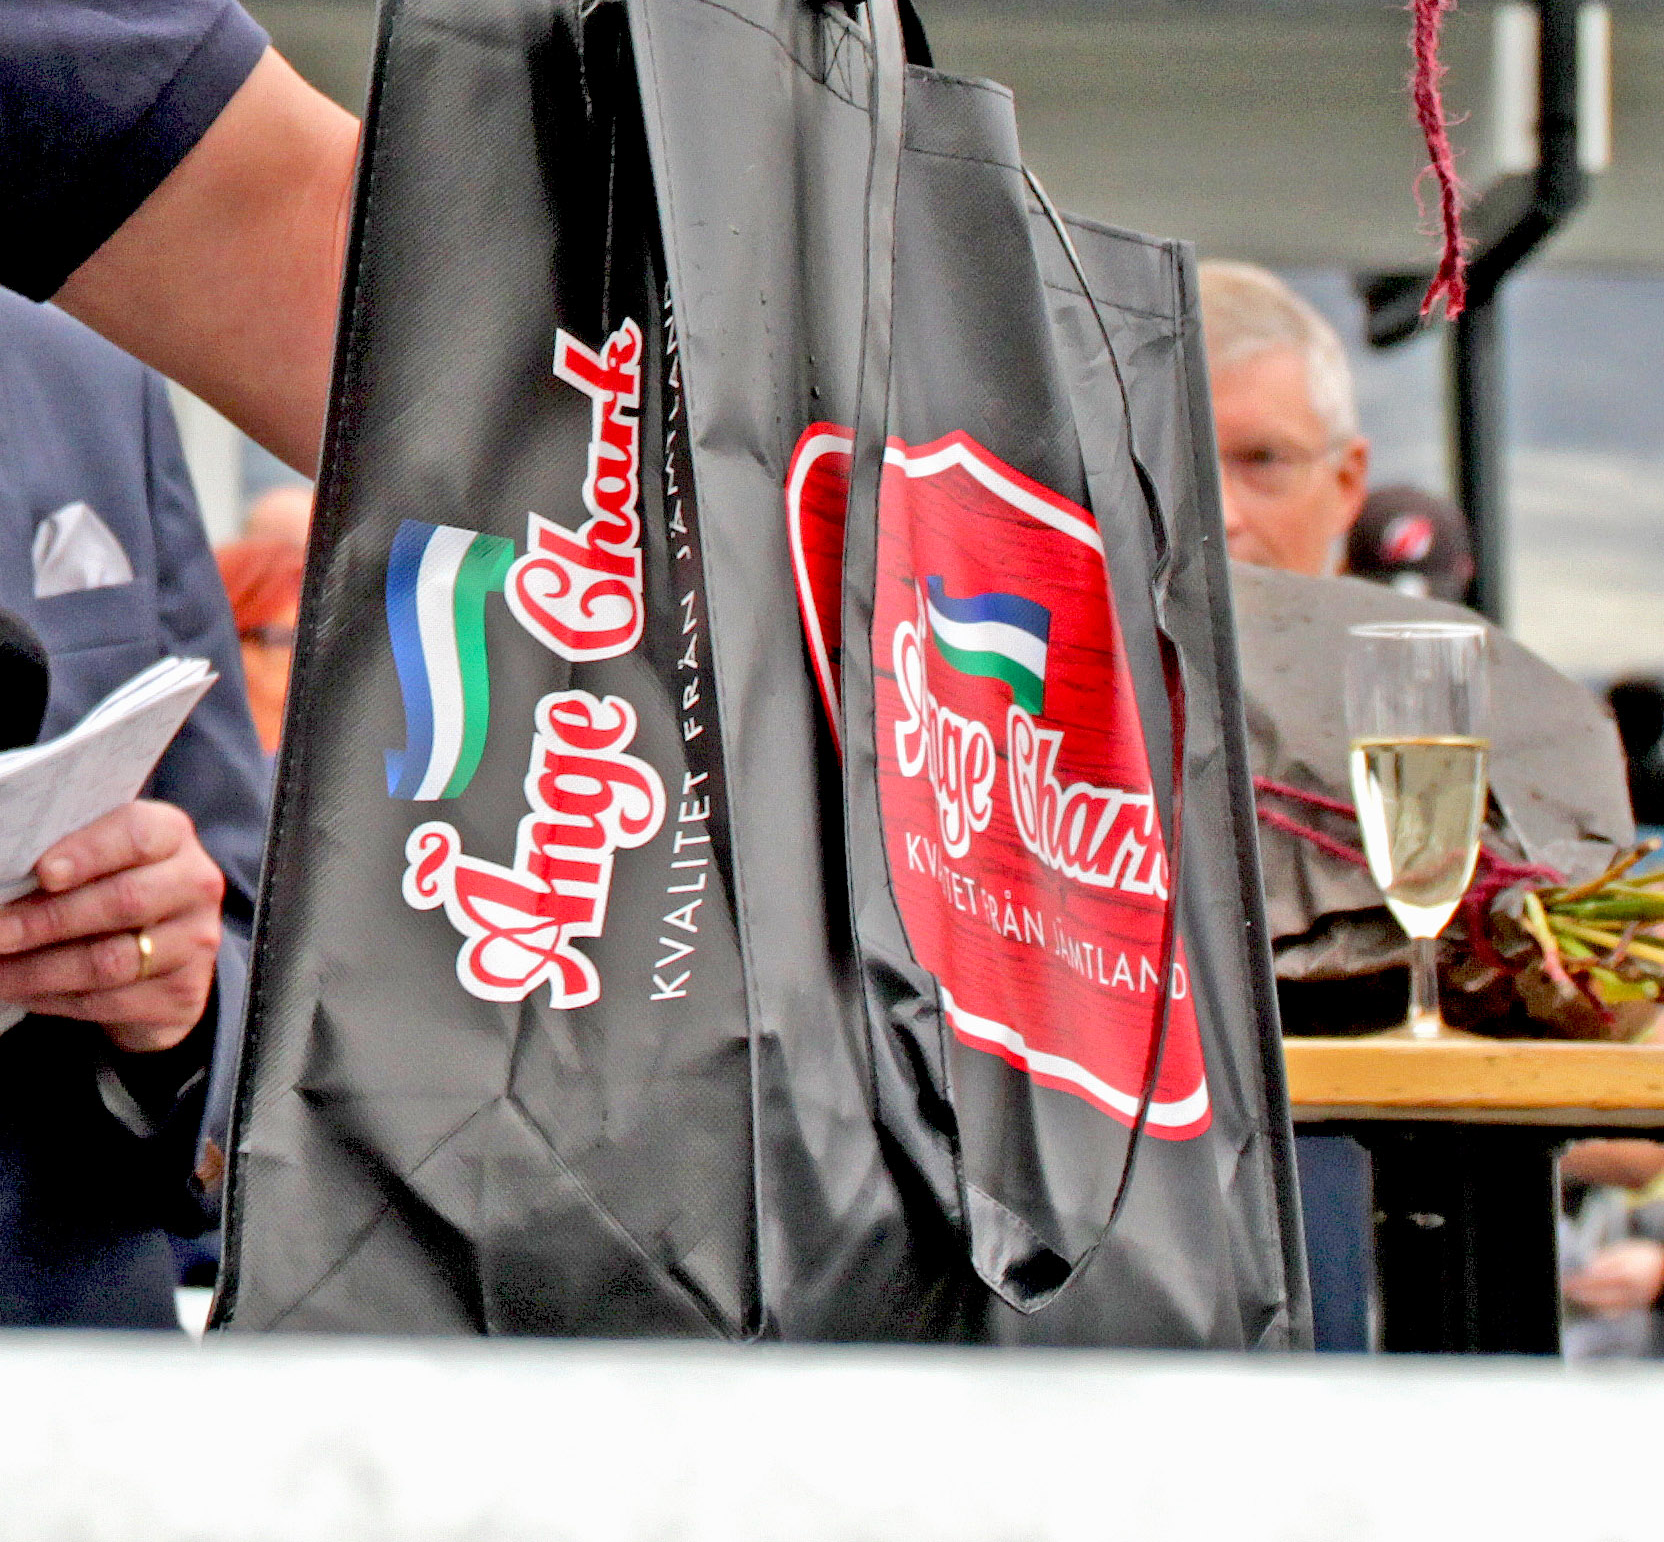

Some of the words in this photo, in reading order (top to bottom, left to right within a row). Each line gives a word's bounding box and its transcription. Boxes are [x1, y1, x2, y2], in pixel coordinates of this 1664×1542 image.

[504, 317, 645, 661] Chark
[678, 590, 704, 741] FRÅN
[651, 772, 711, 1000] KVALITET
